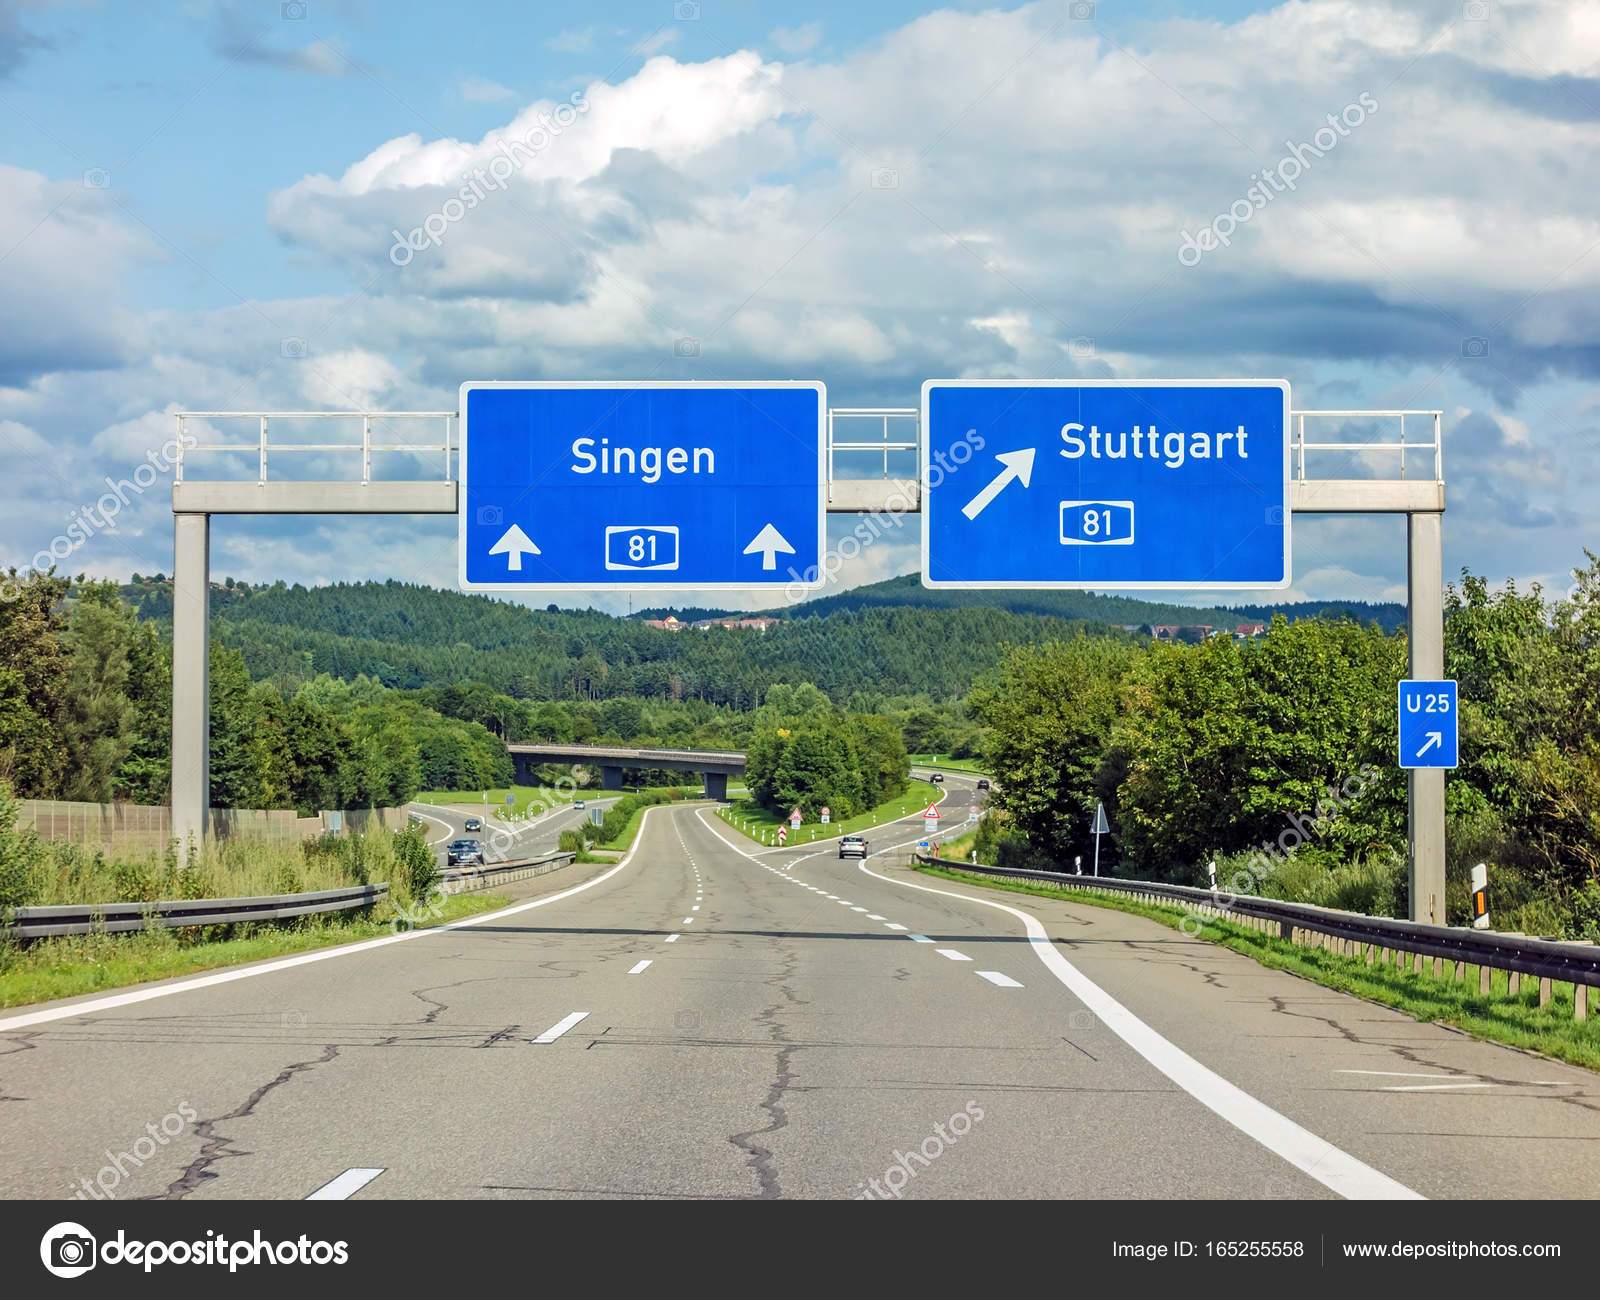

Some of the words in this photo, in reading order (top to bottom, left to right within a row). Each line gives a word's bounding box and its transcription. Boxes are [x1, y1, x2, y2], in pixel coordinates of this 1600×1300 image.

[1059, 422, 1249, 469] Stuttgart
[571, 437, 715, 484] Singen
[1083, 509, 1112, 536] 81
[628, 534, 657, 562] 81
[1406, 693, 1421, 713] U
[1425, 693, 1450, 713] 25
